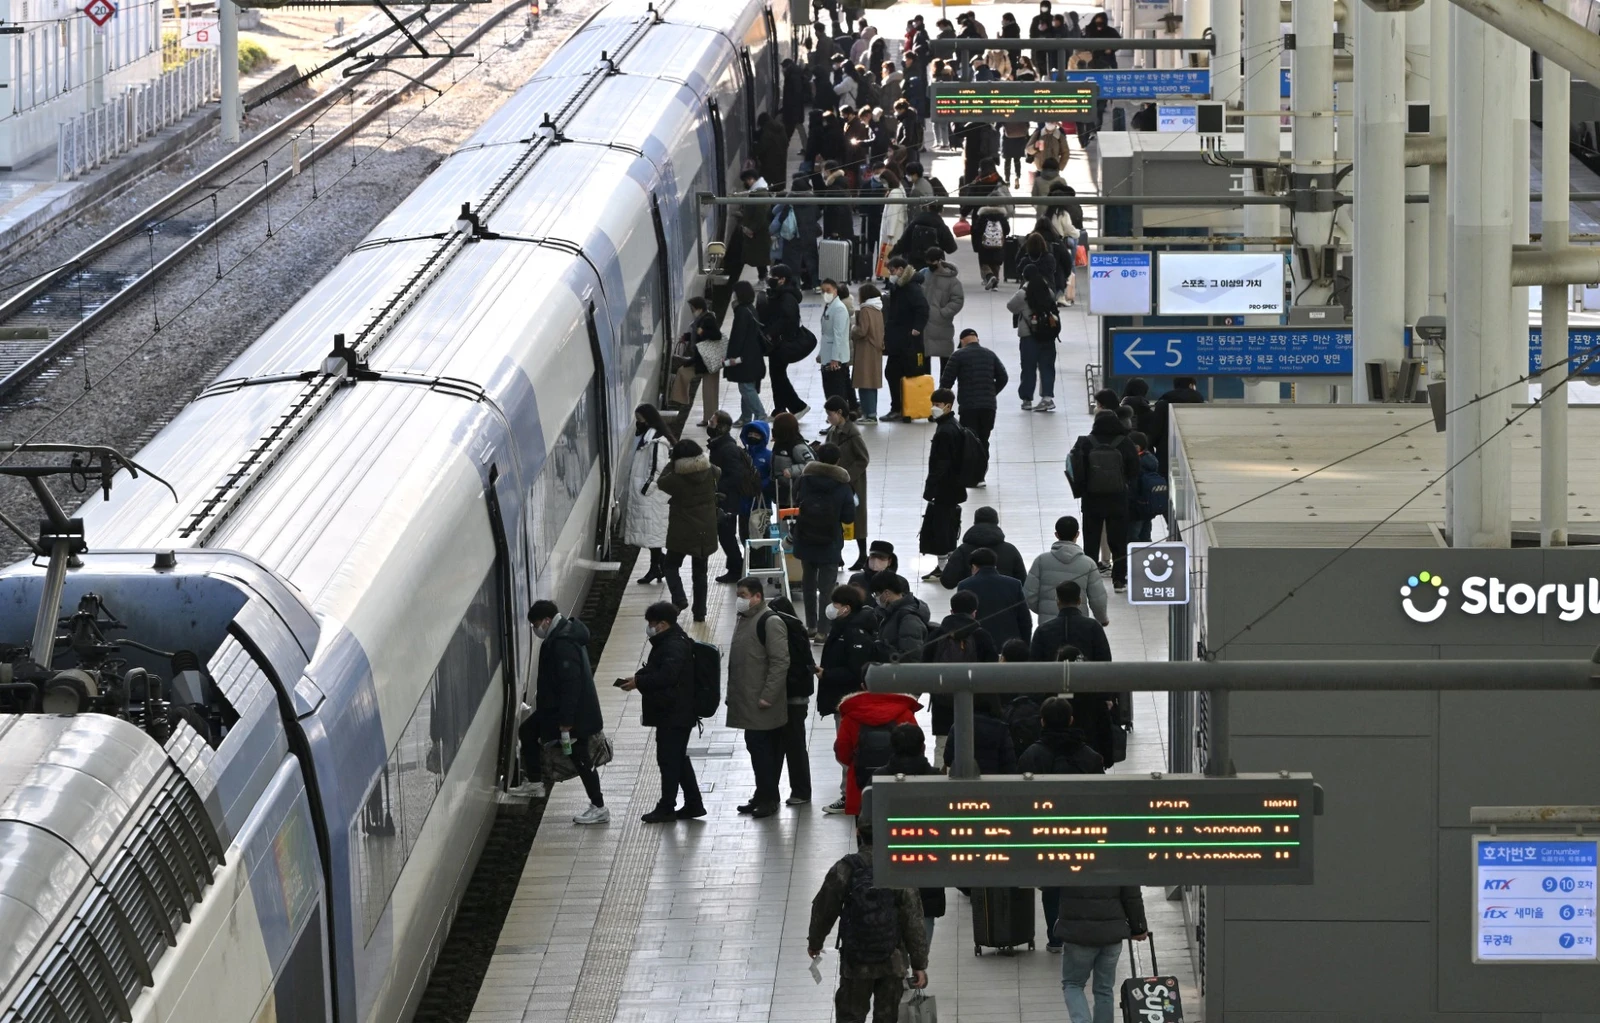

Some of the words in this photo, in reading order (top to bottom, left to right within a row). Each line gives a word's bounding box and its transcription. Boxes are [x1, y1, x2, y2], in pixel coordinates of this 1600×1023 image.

[94, 6, 107, 15] 20
[1092, 270, 1112, 278] KTX
[1181, 279, 1207, 288] 스포츠,
[1210, 279, 1218, 288] 그
[1220, 279, 1244, 288] 이상의
[1246, 279, 1262, 288] 가치
[1196, 335, 1214, 346] 대전
[1218, 335, 1243, 346] 동대구
[1248, 335, 1266, 346] 부산
[1270, 335, 1287, 346] 포항
[1292, 335, 1308, 345] 진주
[1313, 334, 1331, 345] 마산
[1573, 334, 1592, 346] 포항
[1165, 339, 1183, 367] 5
[1196, 355, 1214, 365] 익산
[1218, 354, 1253, 365] 광주송정
[1257, 354, 1274, 365] 목포
[1278, 354, 1320, 365] 여수EXPO
[1323, 354, 1341, 365] 방면
[1142, 587, 1175, 598] 편의점
[1483, 846, 1537, 862] 호차번호
[1483, 878, 1516, 890] KTX
[1514, 906, 1544, 919] 새마을
[1483, 934, 1513, 946] 무궁화
